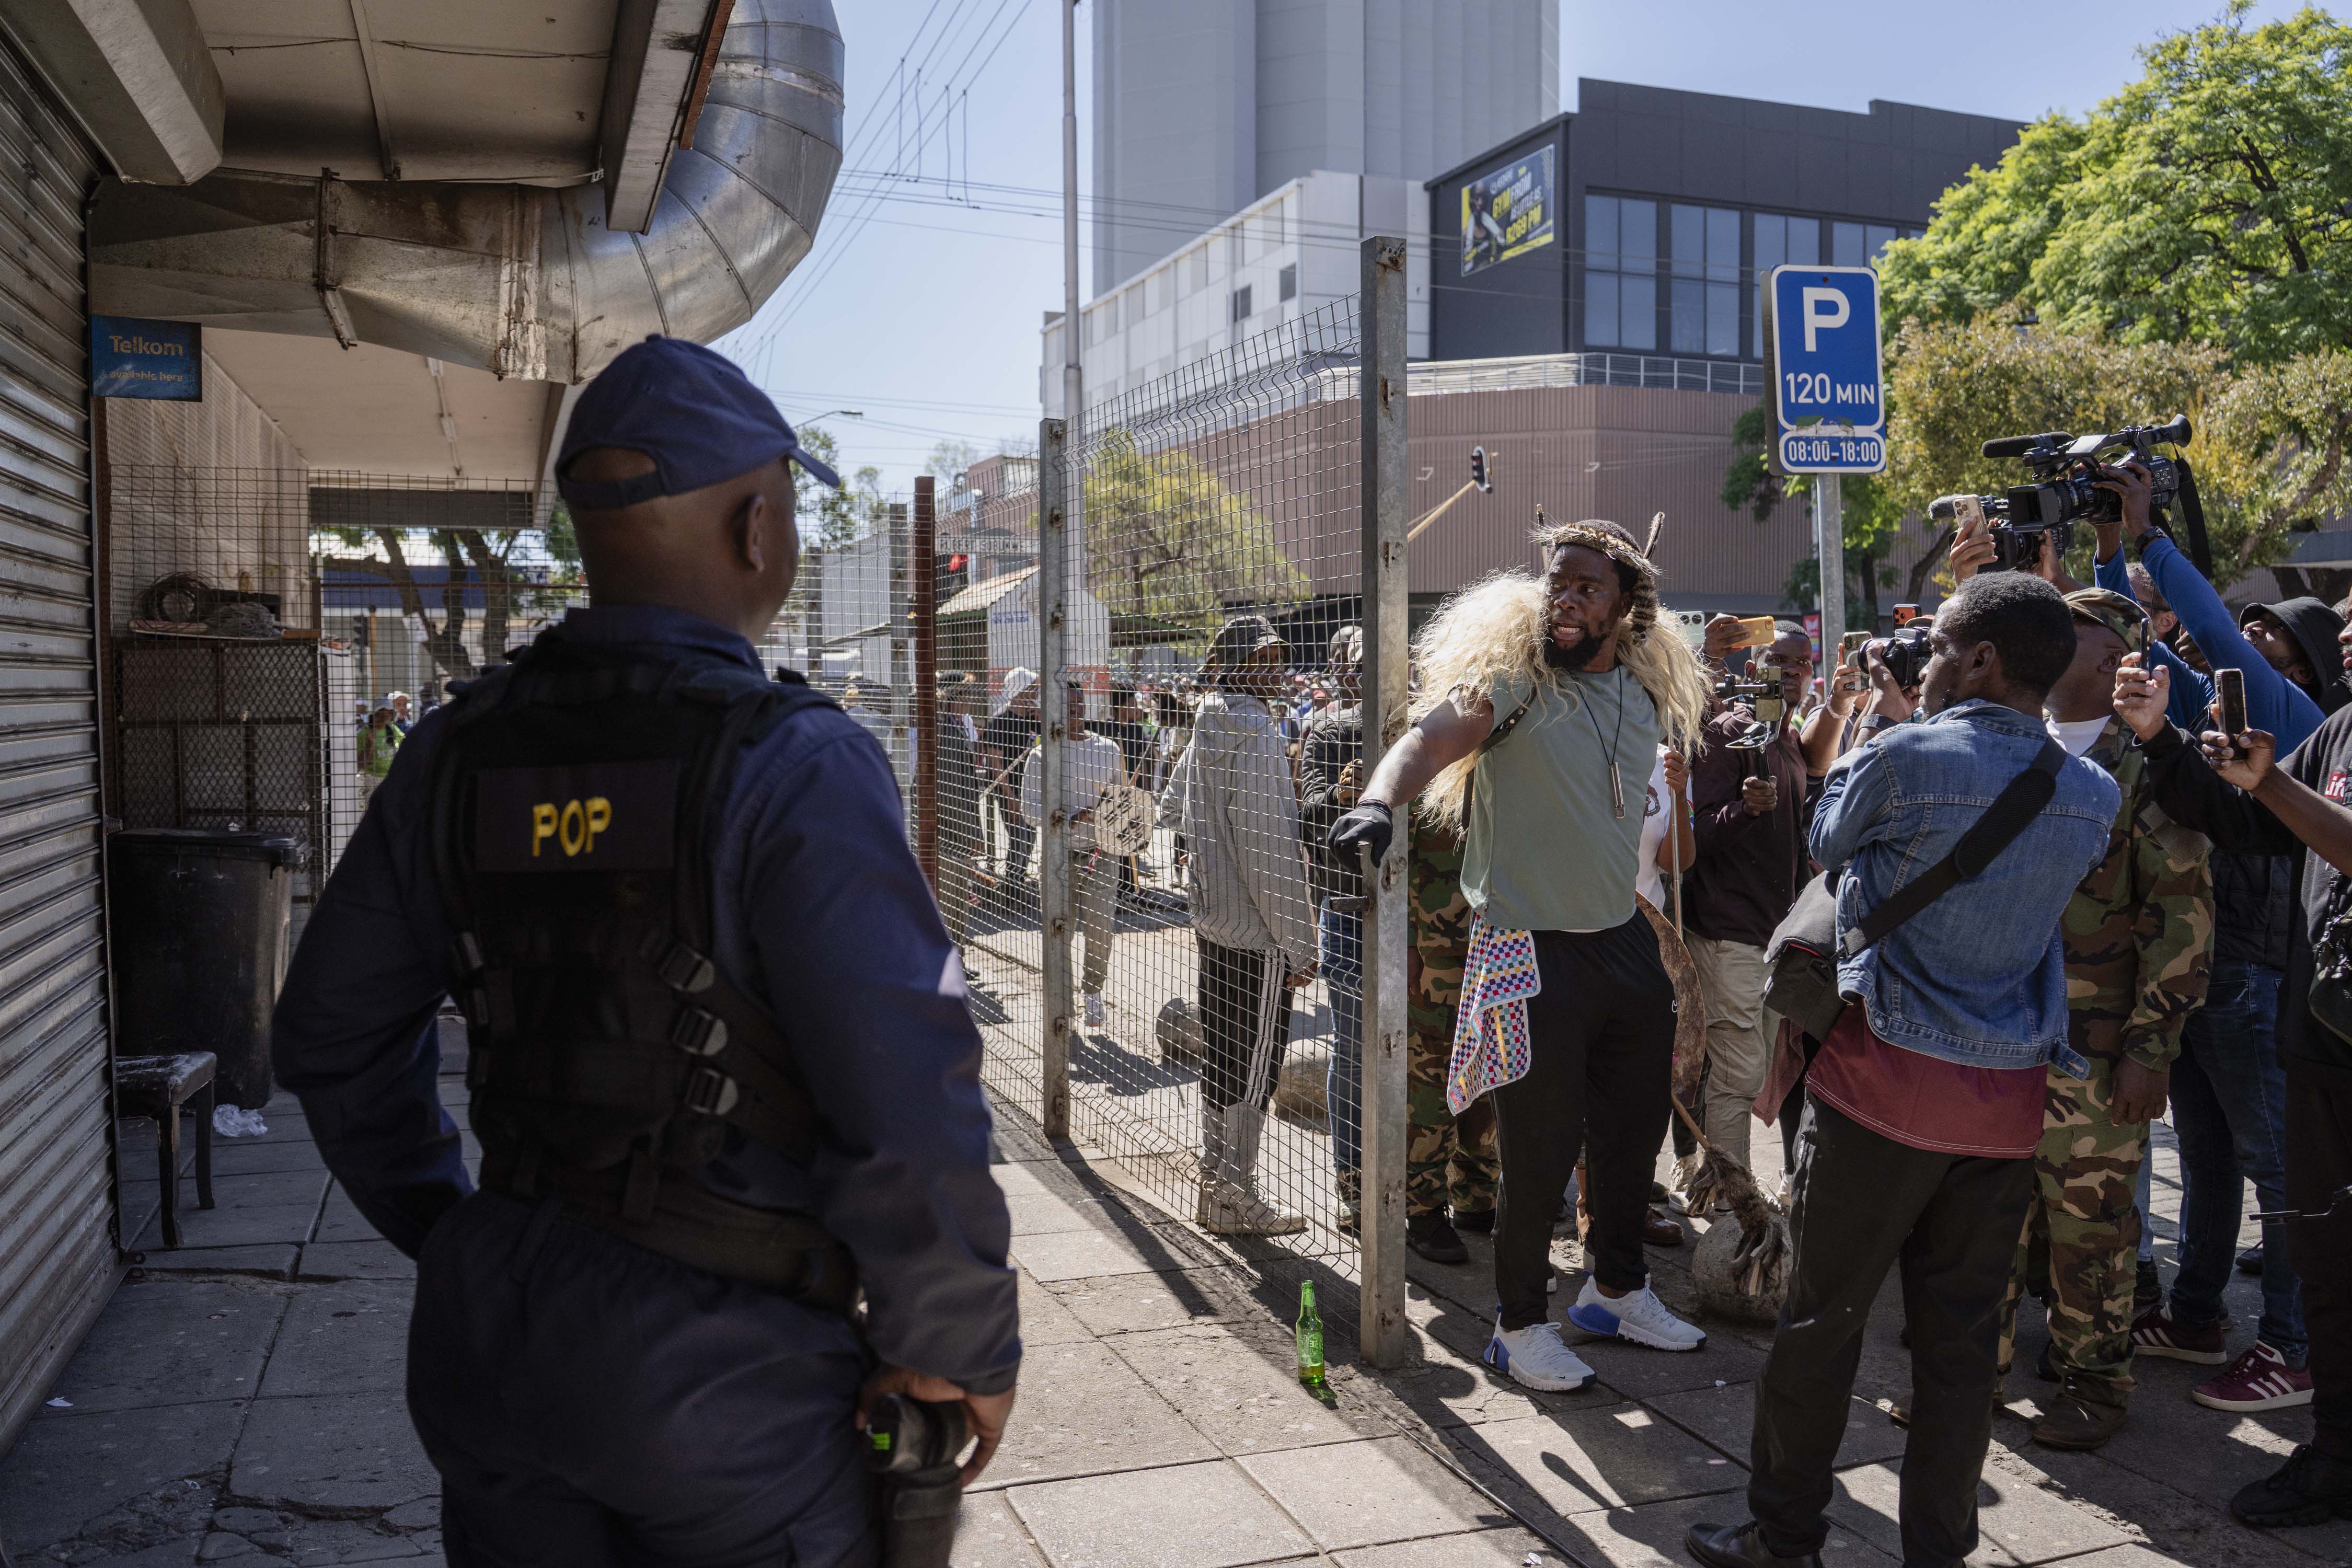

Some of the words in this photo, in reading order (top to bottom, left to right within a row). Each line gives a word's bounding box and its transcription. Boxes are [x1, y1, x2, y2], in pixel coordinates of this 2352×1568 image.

[1492, 187, 1511, 218] GYM
[1511, 171, 1532, 204] FROM
[1506, 215, 1527, 244] R269
[1528, 203, 1541, 229] PM
[1803, 286, 1850, 352] P
[109, 335, 183, 356] Telkom
[109, 370, 157, 381] available
[159, 372, 183, 382] here
[1786, 372, 1830, 404] 120
[1836, 383, 1875, 405] MIN
[1788, 440, 1878, 463] 08:00-18:00
[532, 796, 612, 857] POP
